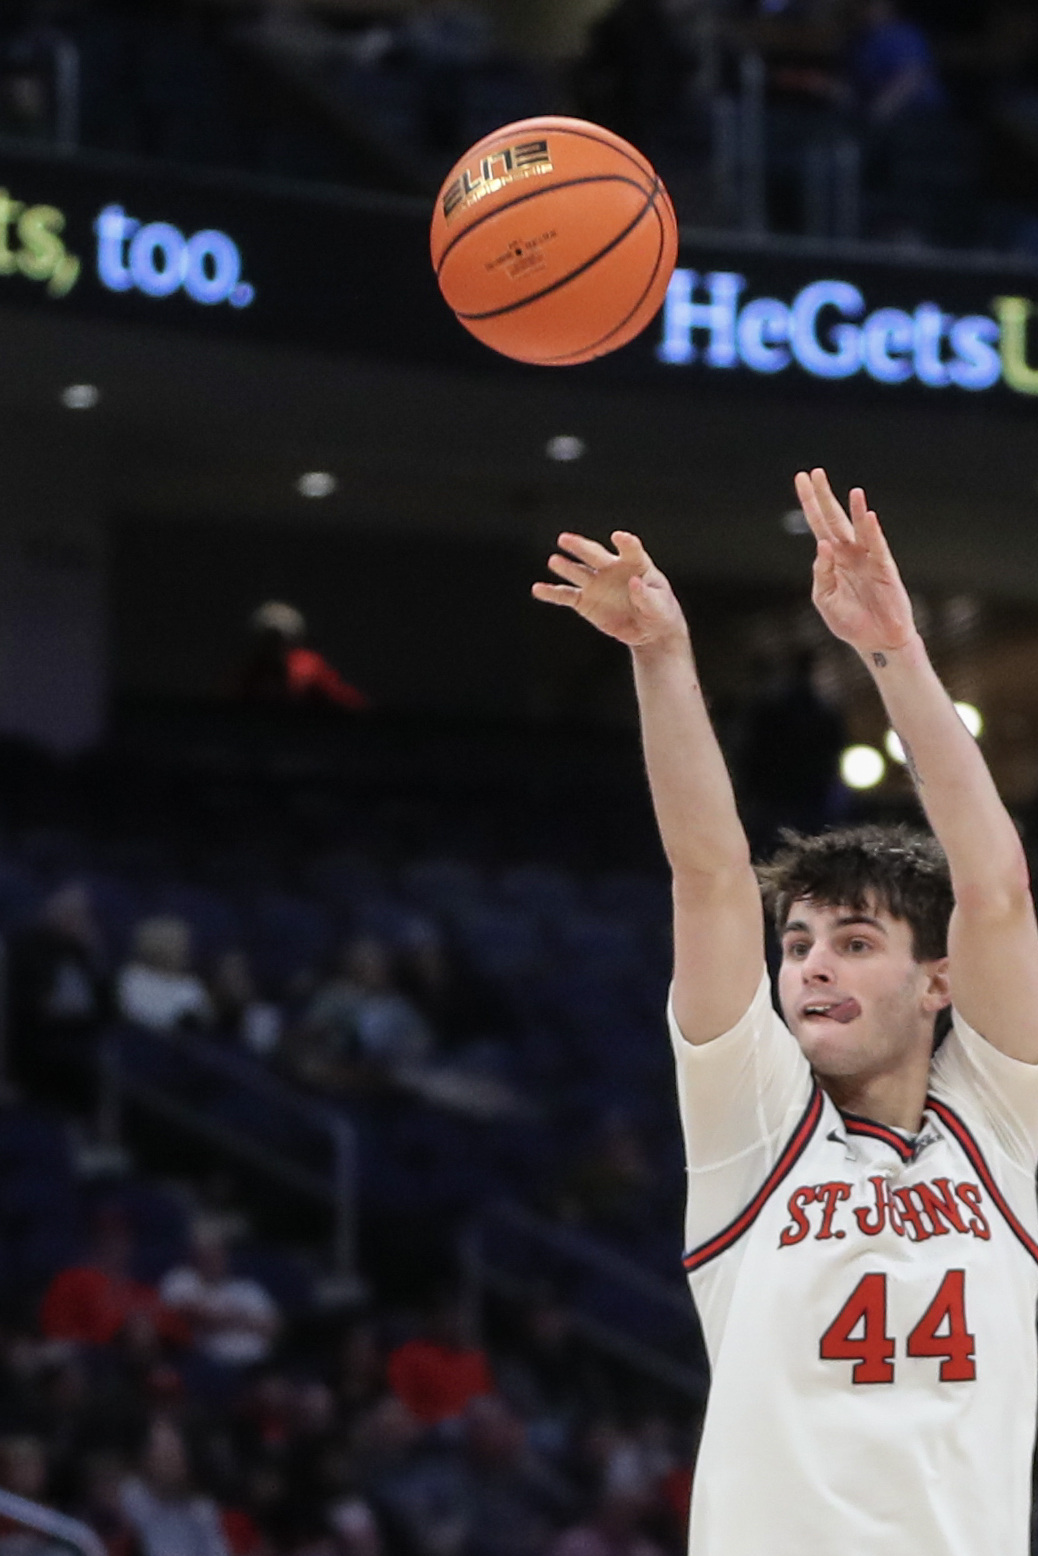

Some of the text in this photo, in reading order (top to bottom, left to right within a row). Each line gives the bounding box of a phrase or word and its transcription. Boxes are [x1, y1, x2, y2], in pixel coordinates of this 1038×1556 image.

[446, 163, 554, 228] AMPIONSHIP
[94, 204, 255, 308] too.
[777, 1181, 854, 1249] ST.
[819, 1268, 977, 1385] 44
